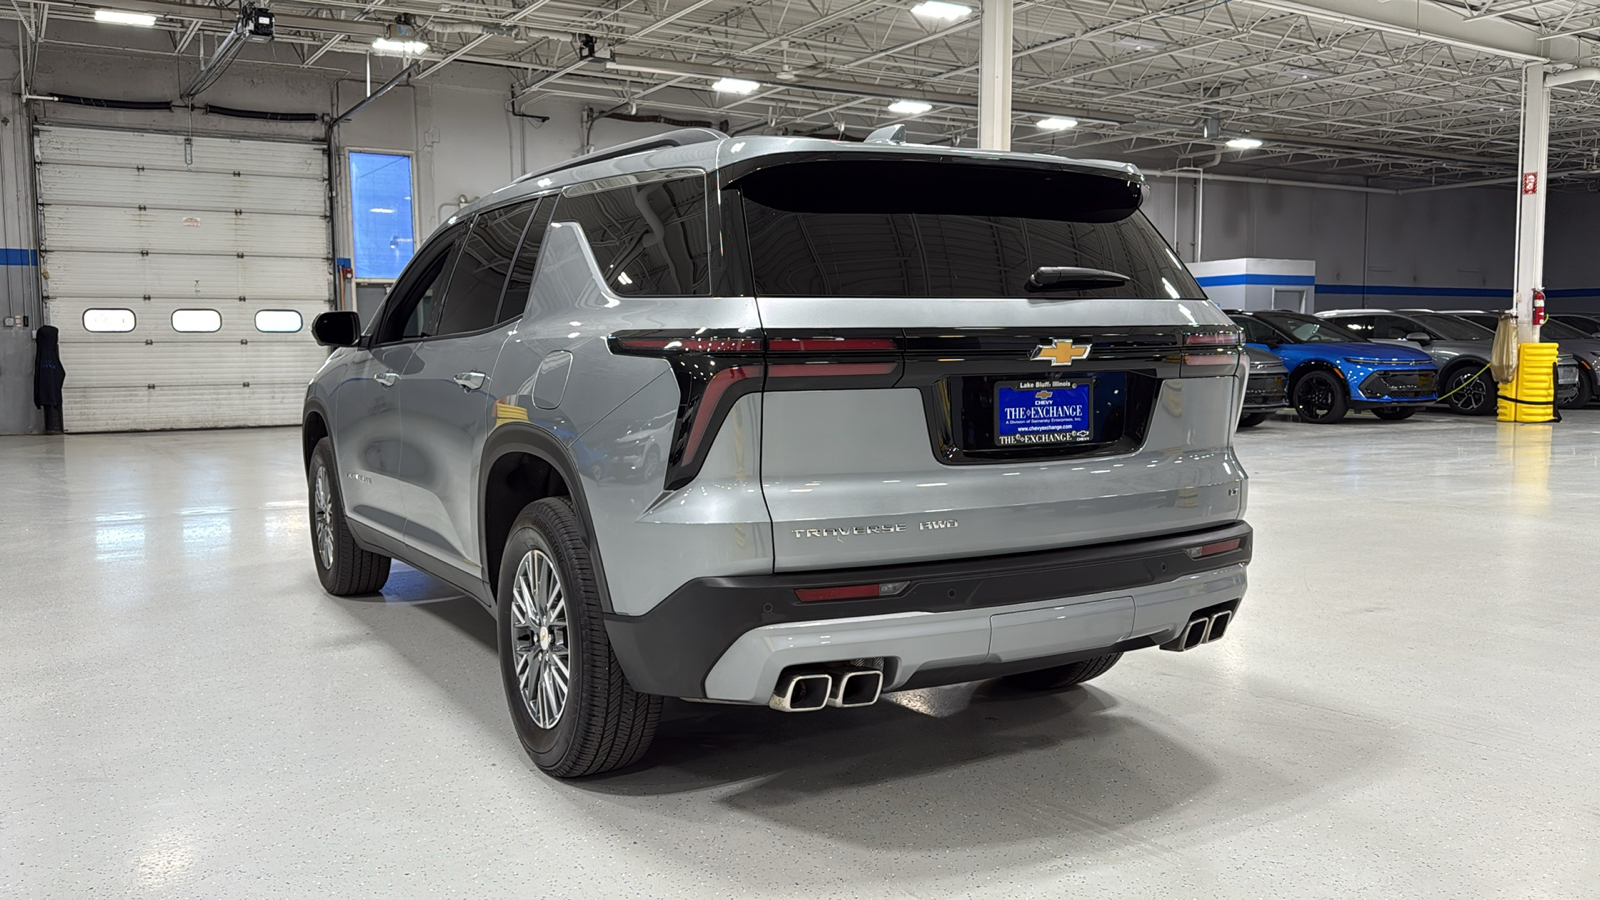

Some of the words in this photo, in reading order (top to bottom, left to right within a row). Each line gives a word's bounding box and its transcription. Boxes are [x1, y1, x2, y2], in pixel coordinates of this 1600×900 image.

[1005, 407, 1026, 420] THE
[1031, 405, 1082, 418] EXCHANGE
[999, 436, 1016, 444] THE
[1024, 432, 1072, 444] EXCHANGE
[792, 524, 907, 538] TRAVERSE
[919, 520, 958, 531] AWD
